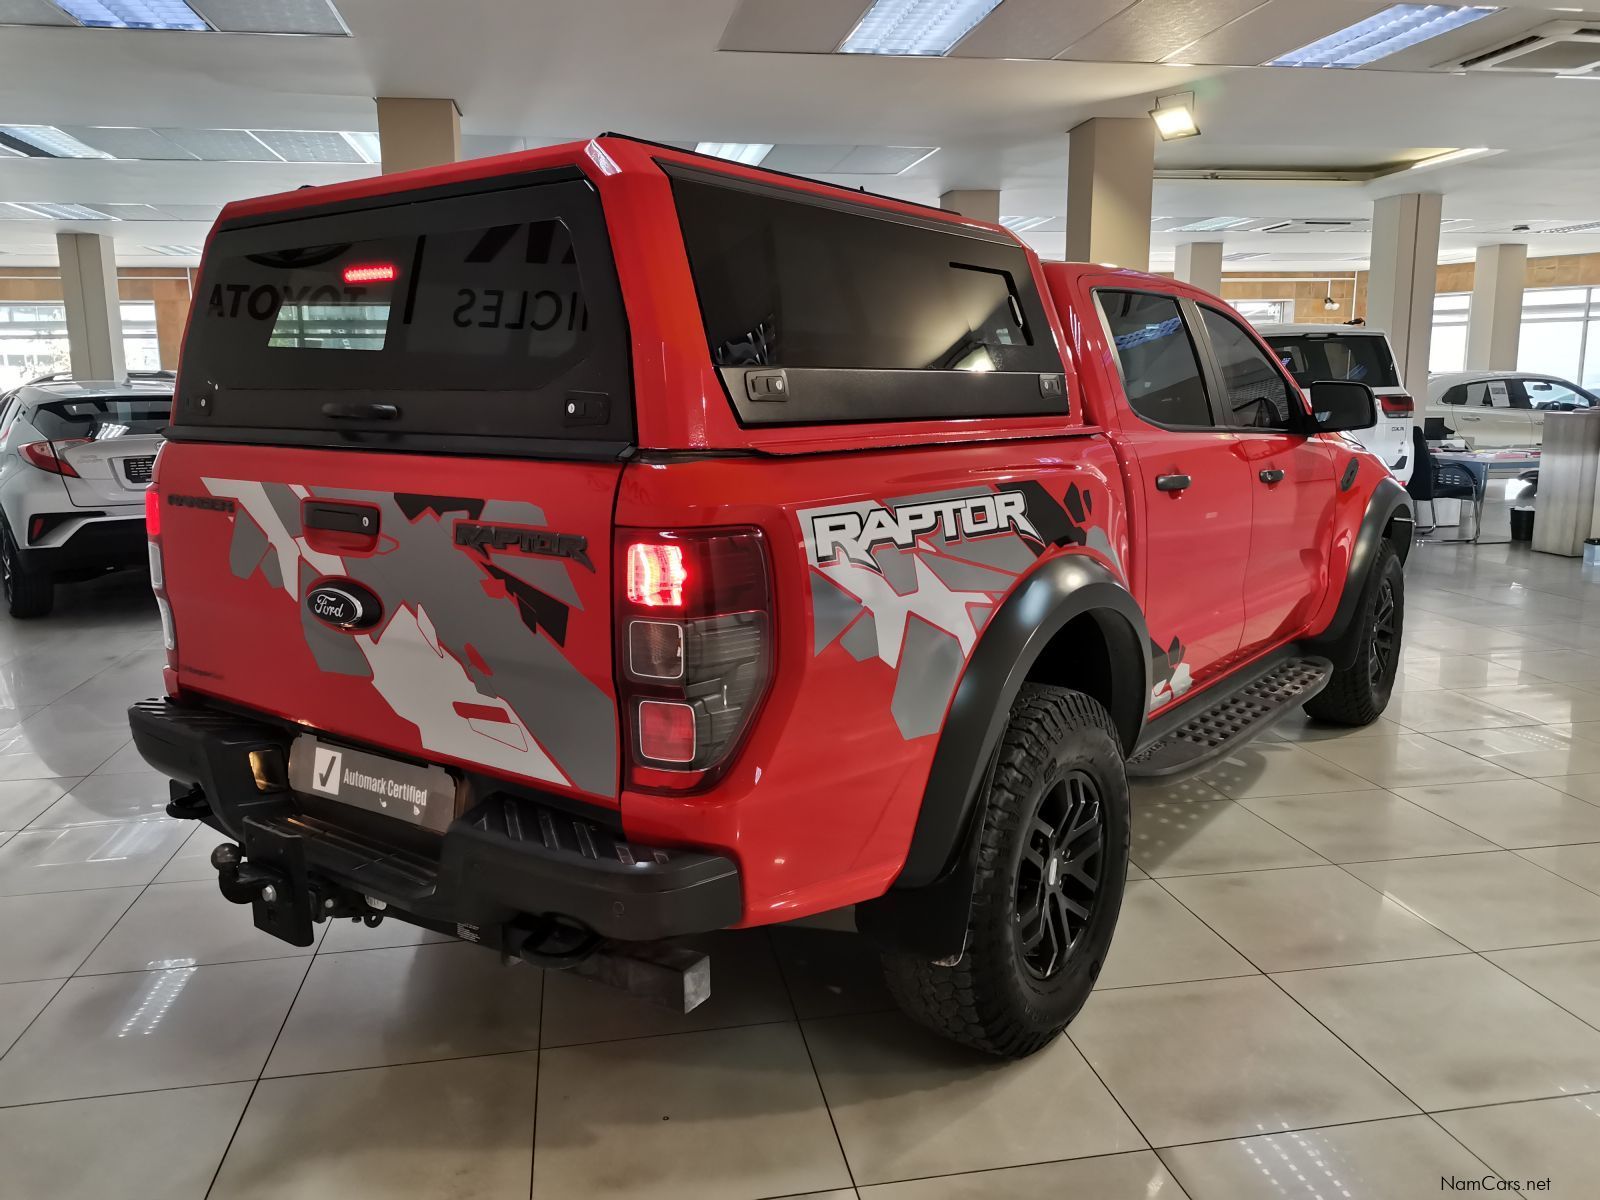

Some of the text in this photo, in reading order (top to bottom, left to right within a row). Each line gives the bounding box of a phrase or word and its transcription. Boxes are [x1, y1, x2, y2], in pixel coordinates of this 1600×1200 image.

[455, 523, 596, 574] RAPTOR
[811, 490, 1046, 575] RAPTOR
[314, 594, 345, 618] Ford
[343, 768, 428, 807] Automark Certified
